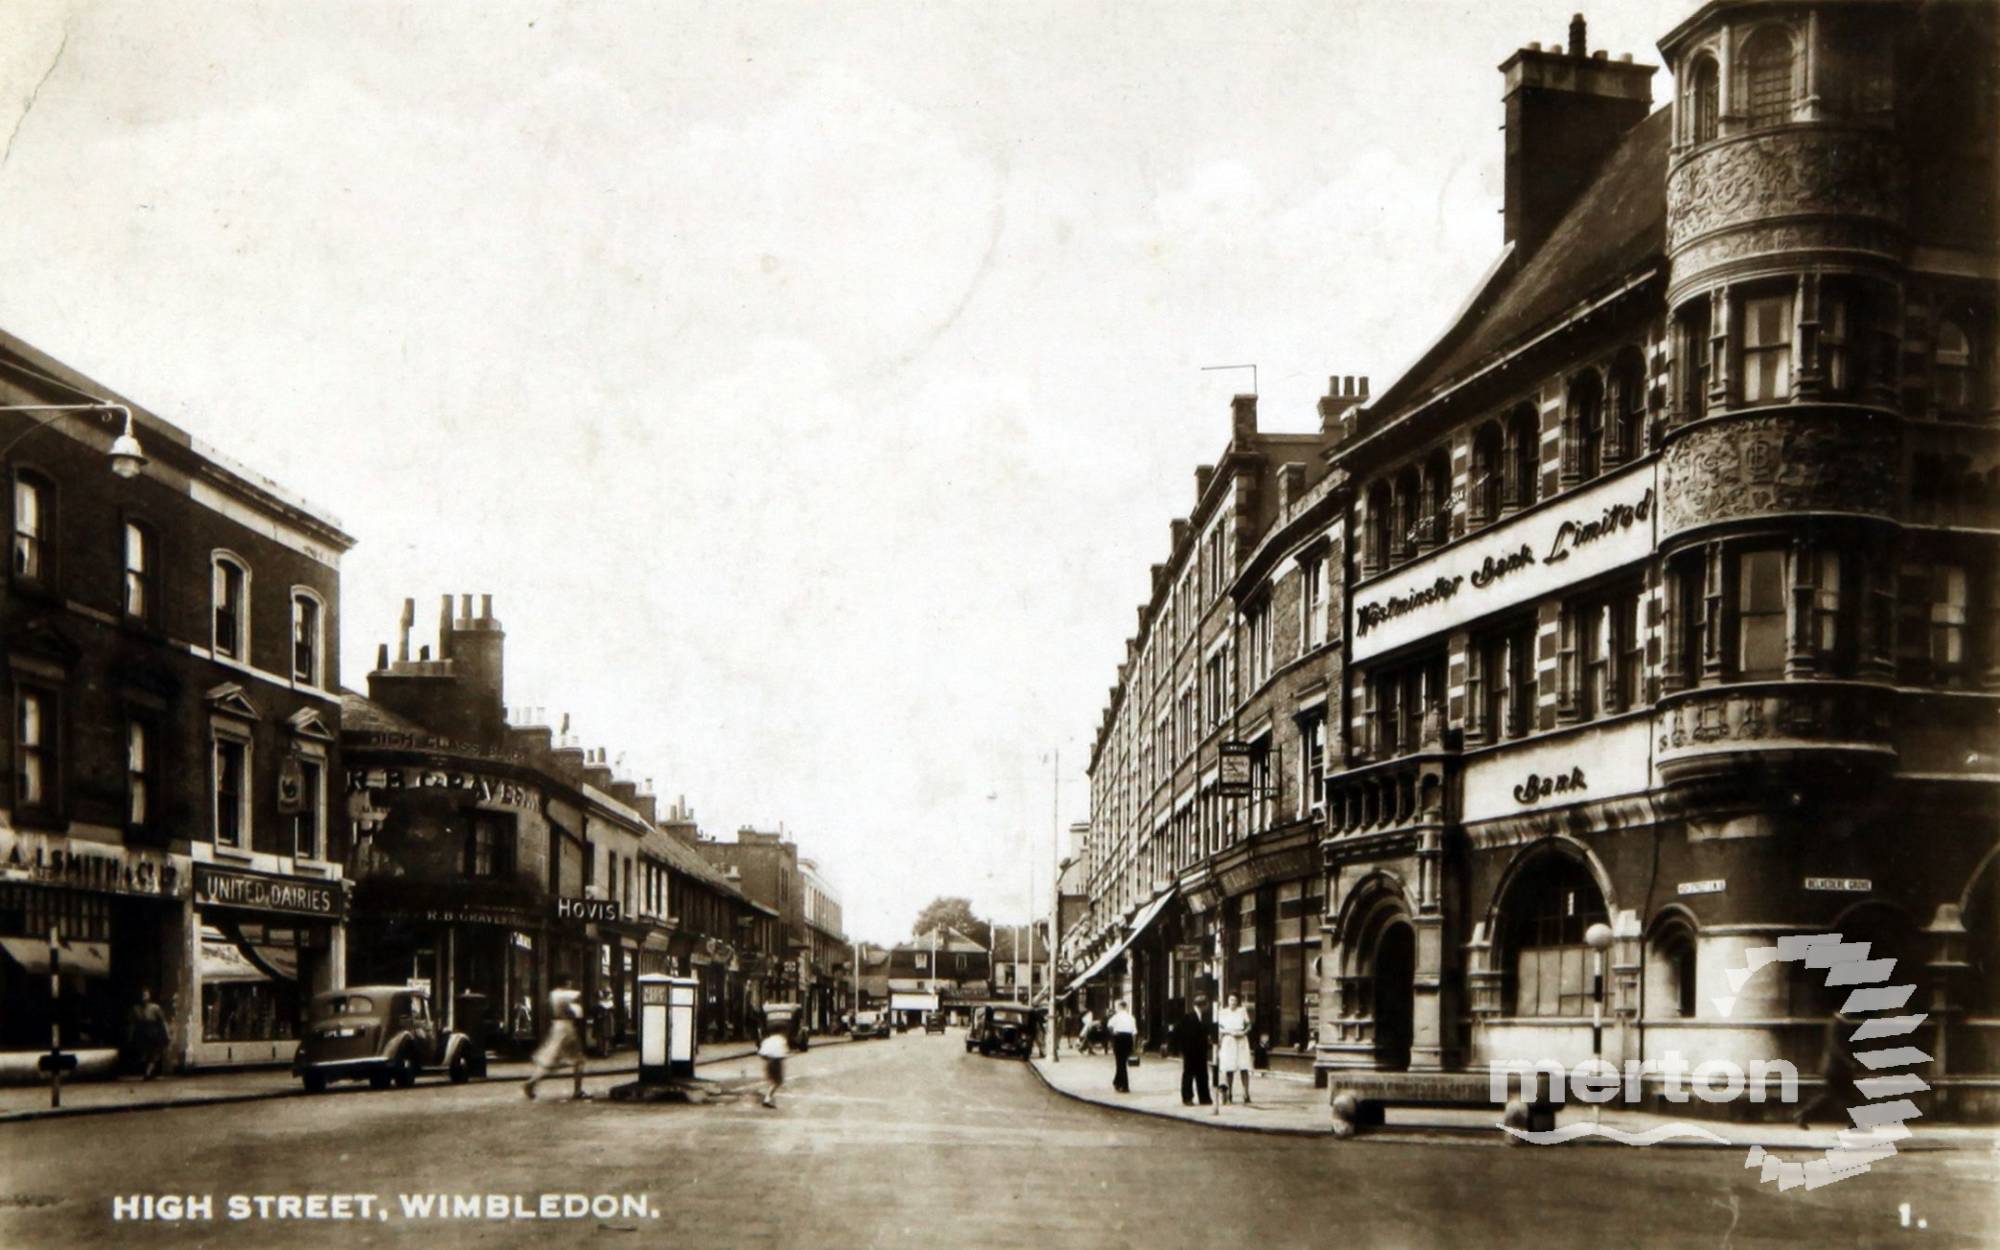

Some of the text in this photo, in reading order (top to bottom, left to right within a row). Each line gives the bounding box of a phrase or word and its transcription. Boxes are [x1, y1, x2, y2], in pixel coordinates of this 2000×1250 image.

[1356, 488, 1653, 637] Westminster Bank Limited
[1514, 766, 1587, 804] Bank
[207, 875, 265, 904] UNITED
[271, 884, 331, 912] DAIRIES
[558, 898, 616, 920] HOVIS
